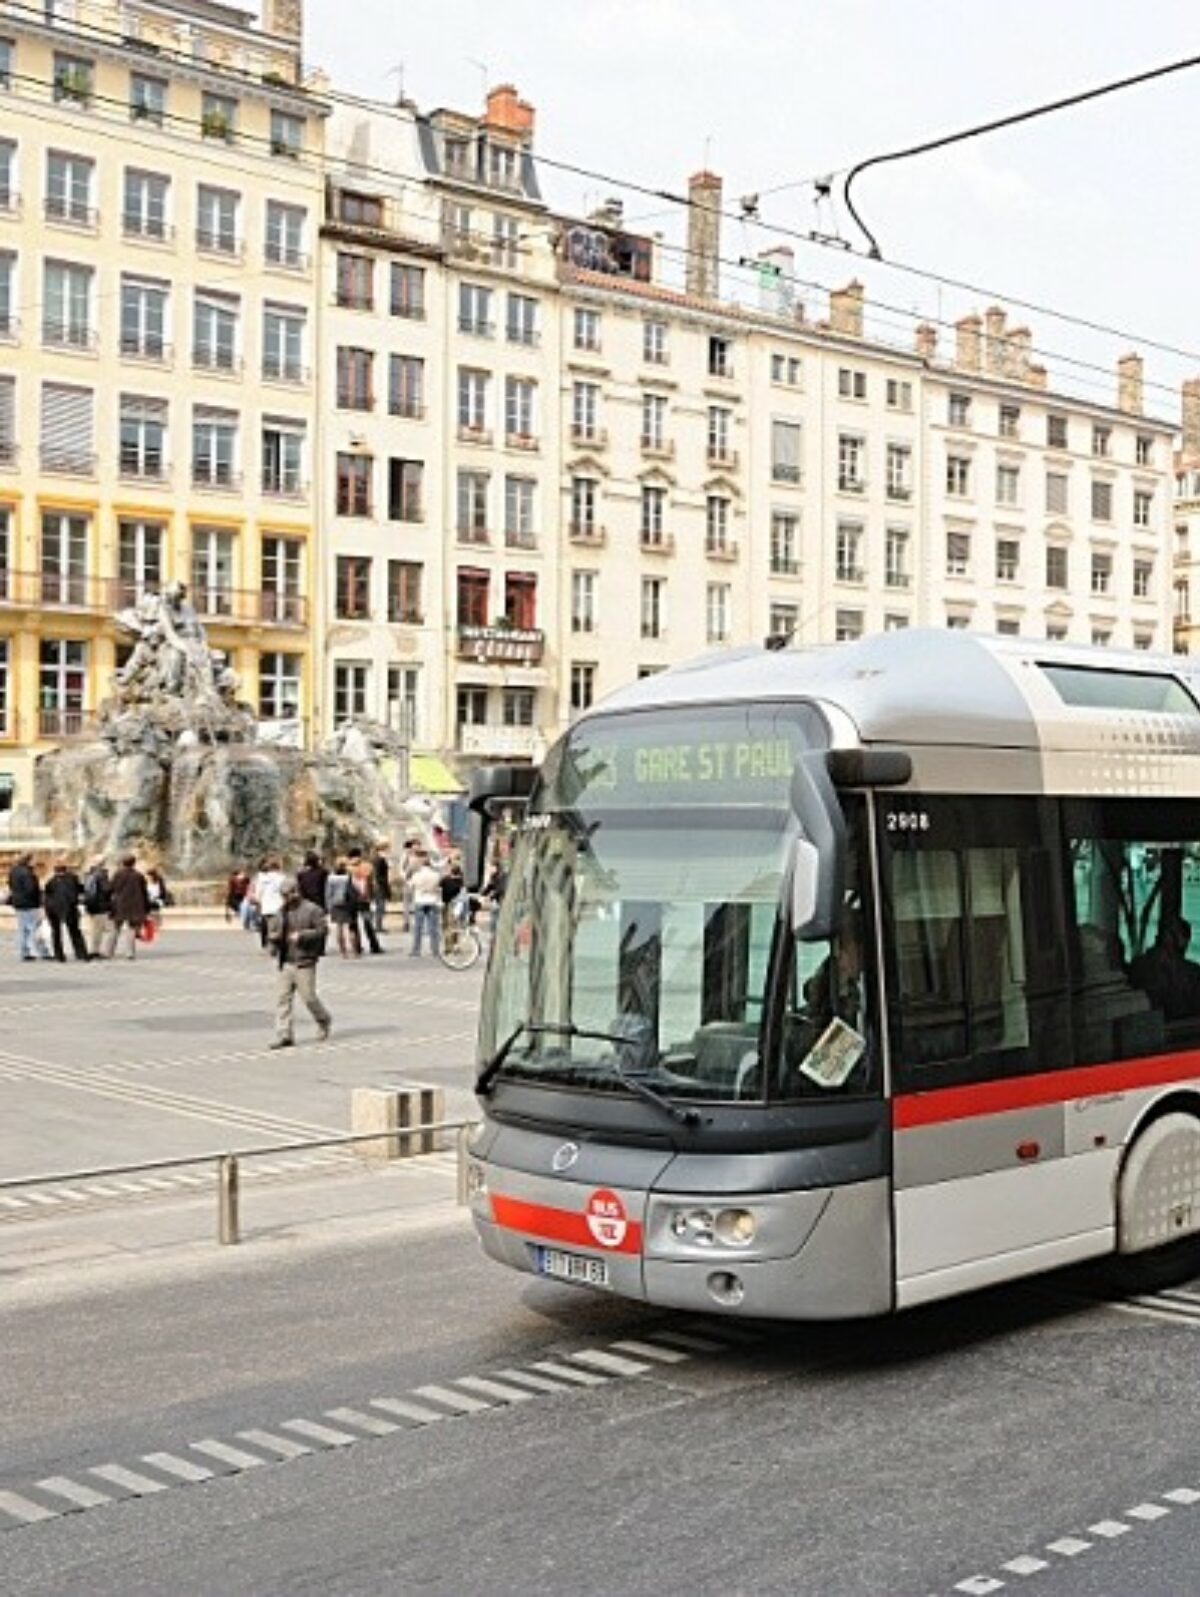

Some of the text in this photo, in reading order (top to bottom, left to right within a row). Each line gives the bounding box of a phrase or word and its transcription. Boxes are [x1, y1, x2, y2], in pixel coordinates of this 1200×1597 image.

[635, 745, 692, 784] GARE
[699, 742, 727, 780] ST
[735, 739, 794, 778] PAUL
